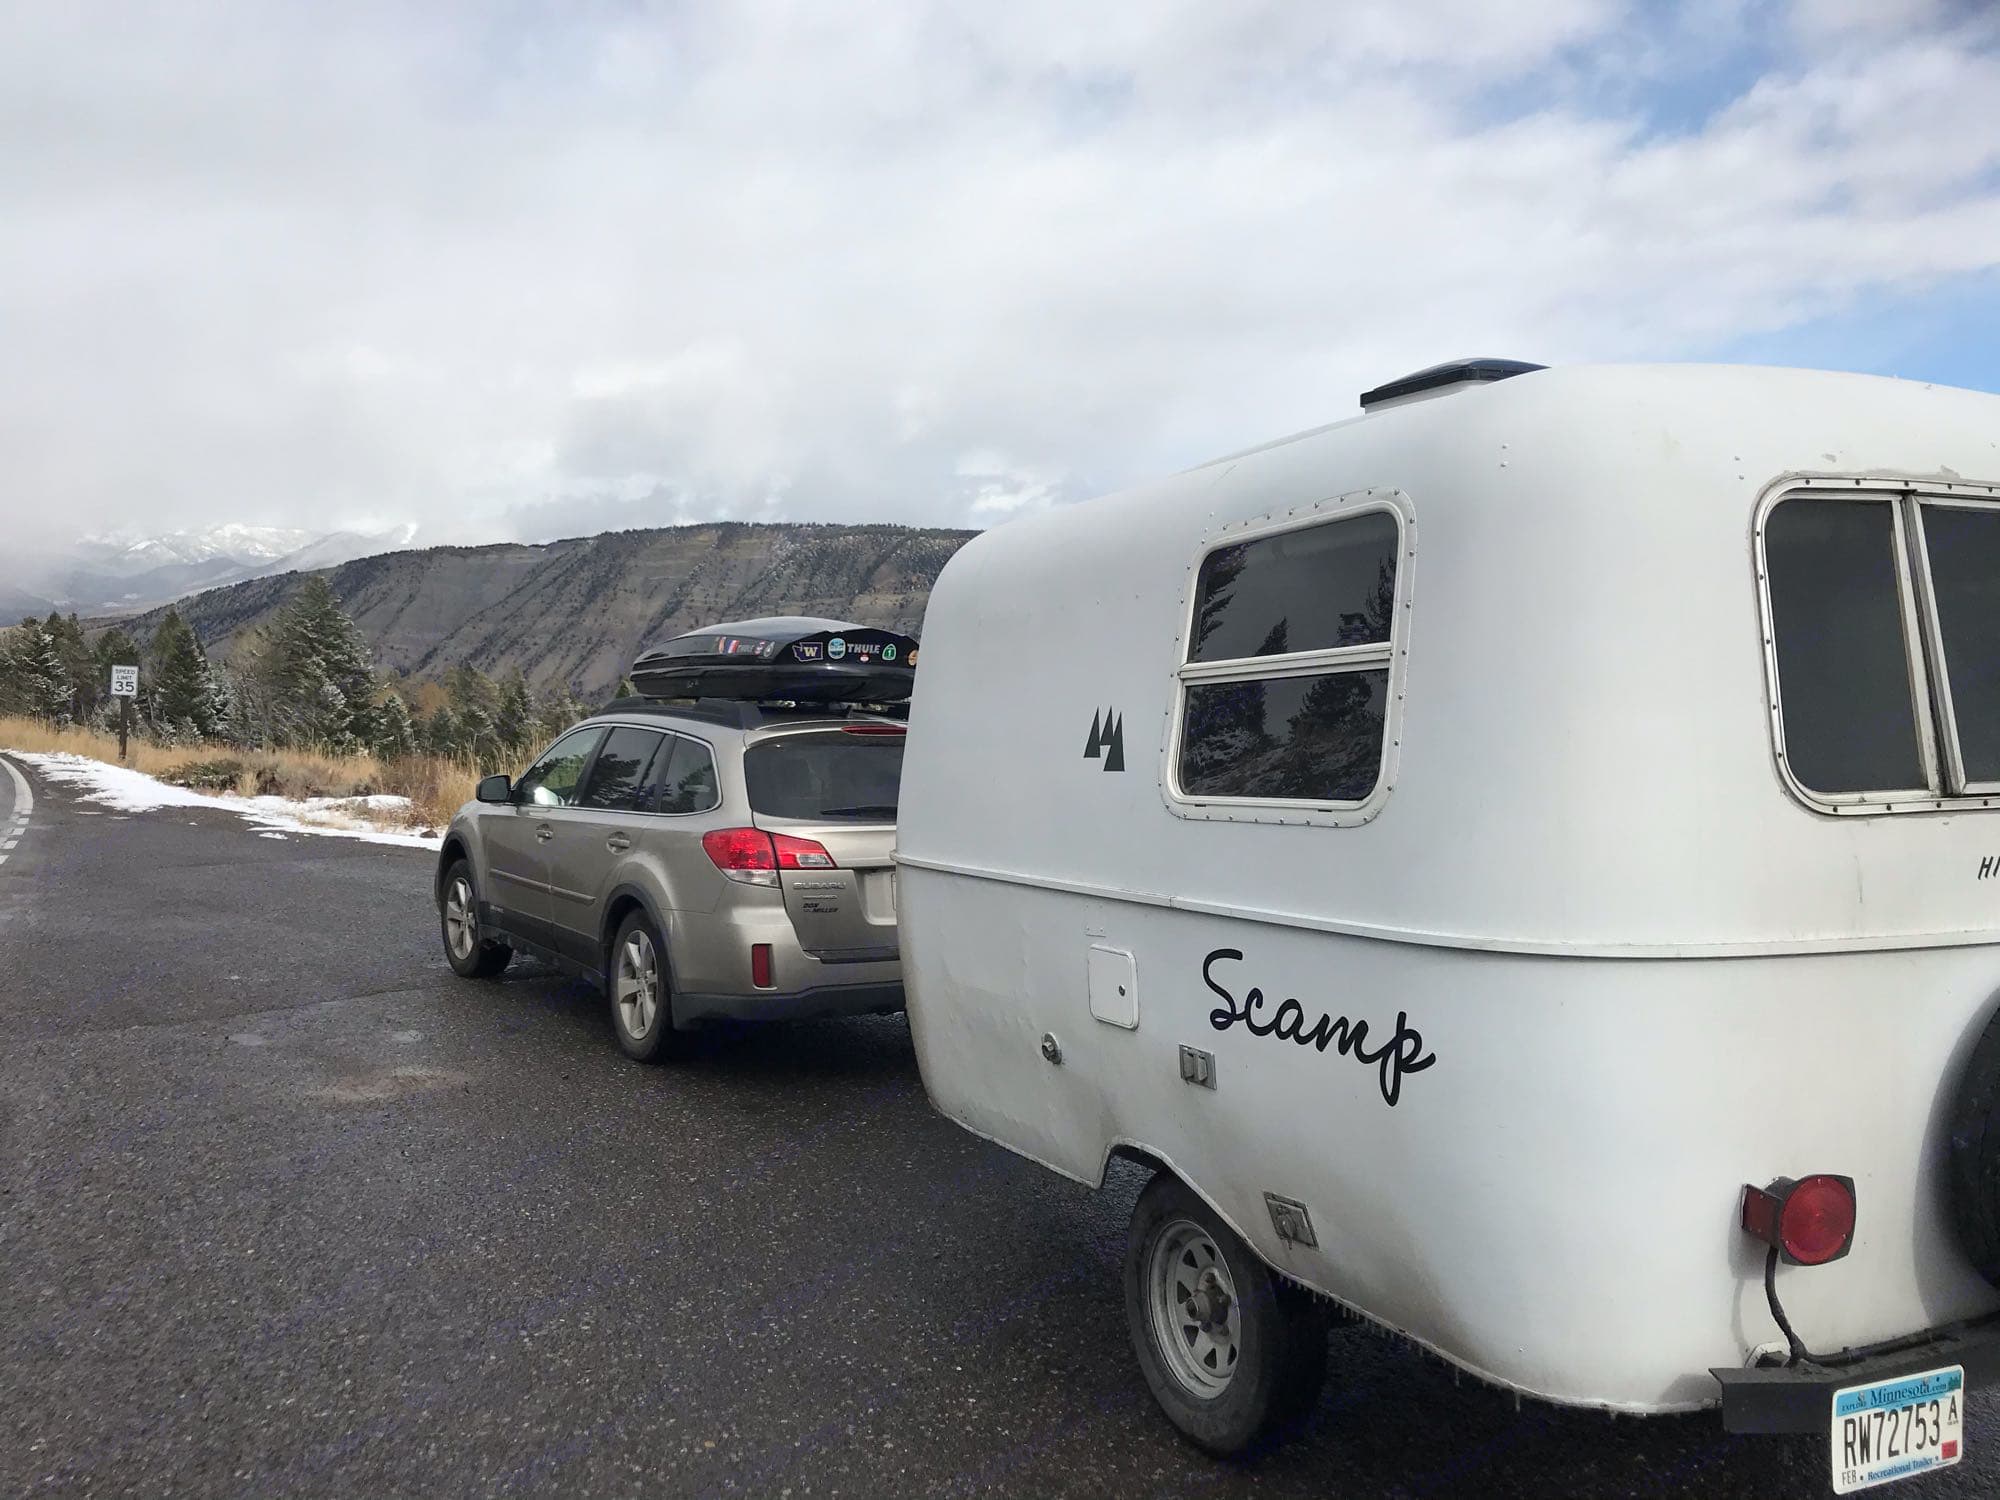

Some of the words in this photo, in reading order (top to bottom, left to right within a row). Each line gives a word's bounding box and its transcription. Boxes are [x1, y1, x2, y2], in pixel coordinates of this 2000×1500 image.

[803, 646, 819, 657] W
[847, 643, 881, 654] THULE
[115, 680, 135, 692] 35
[793, 882, 846, 890] SUBARU
[1203, 948, 1437, 1107] Scamp
[1844, 1399, 1940, 1469] RW72753
[1841, 1469, 1857, 1486] FEB
